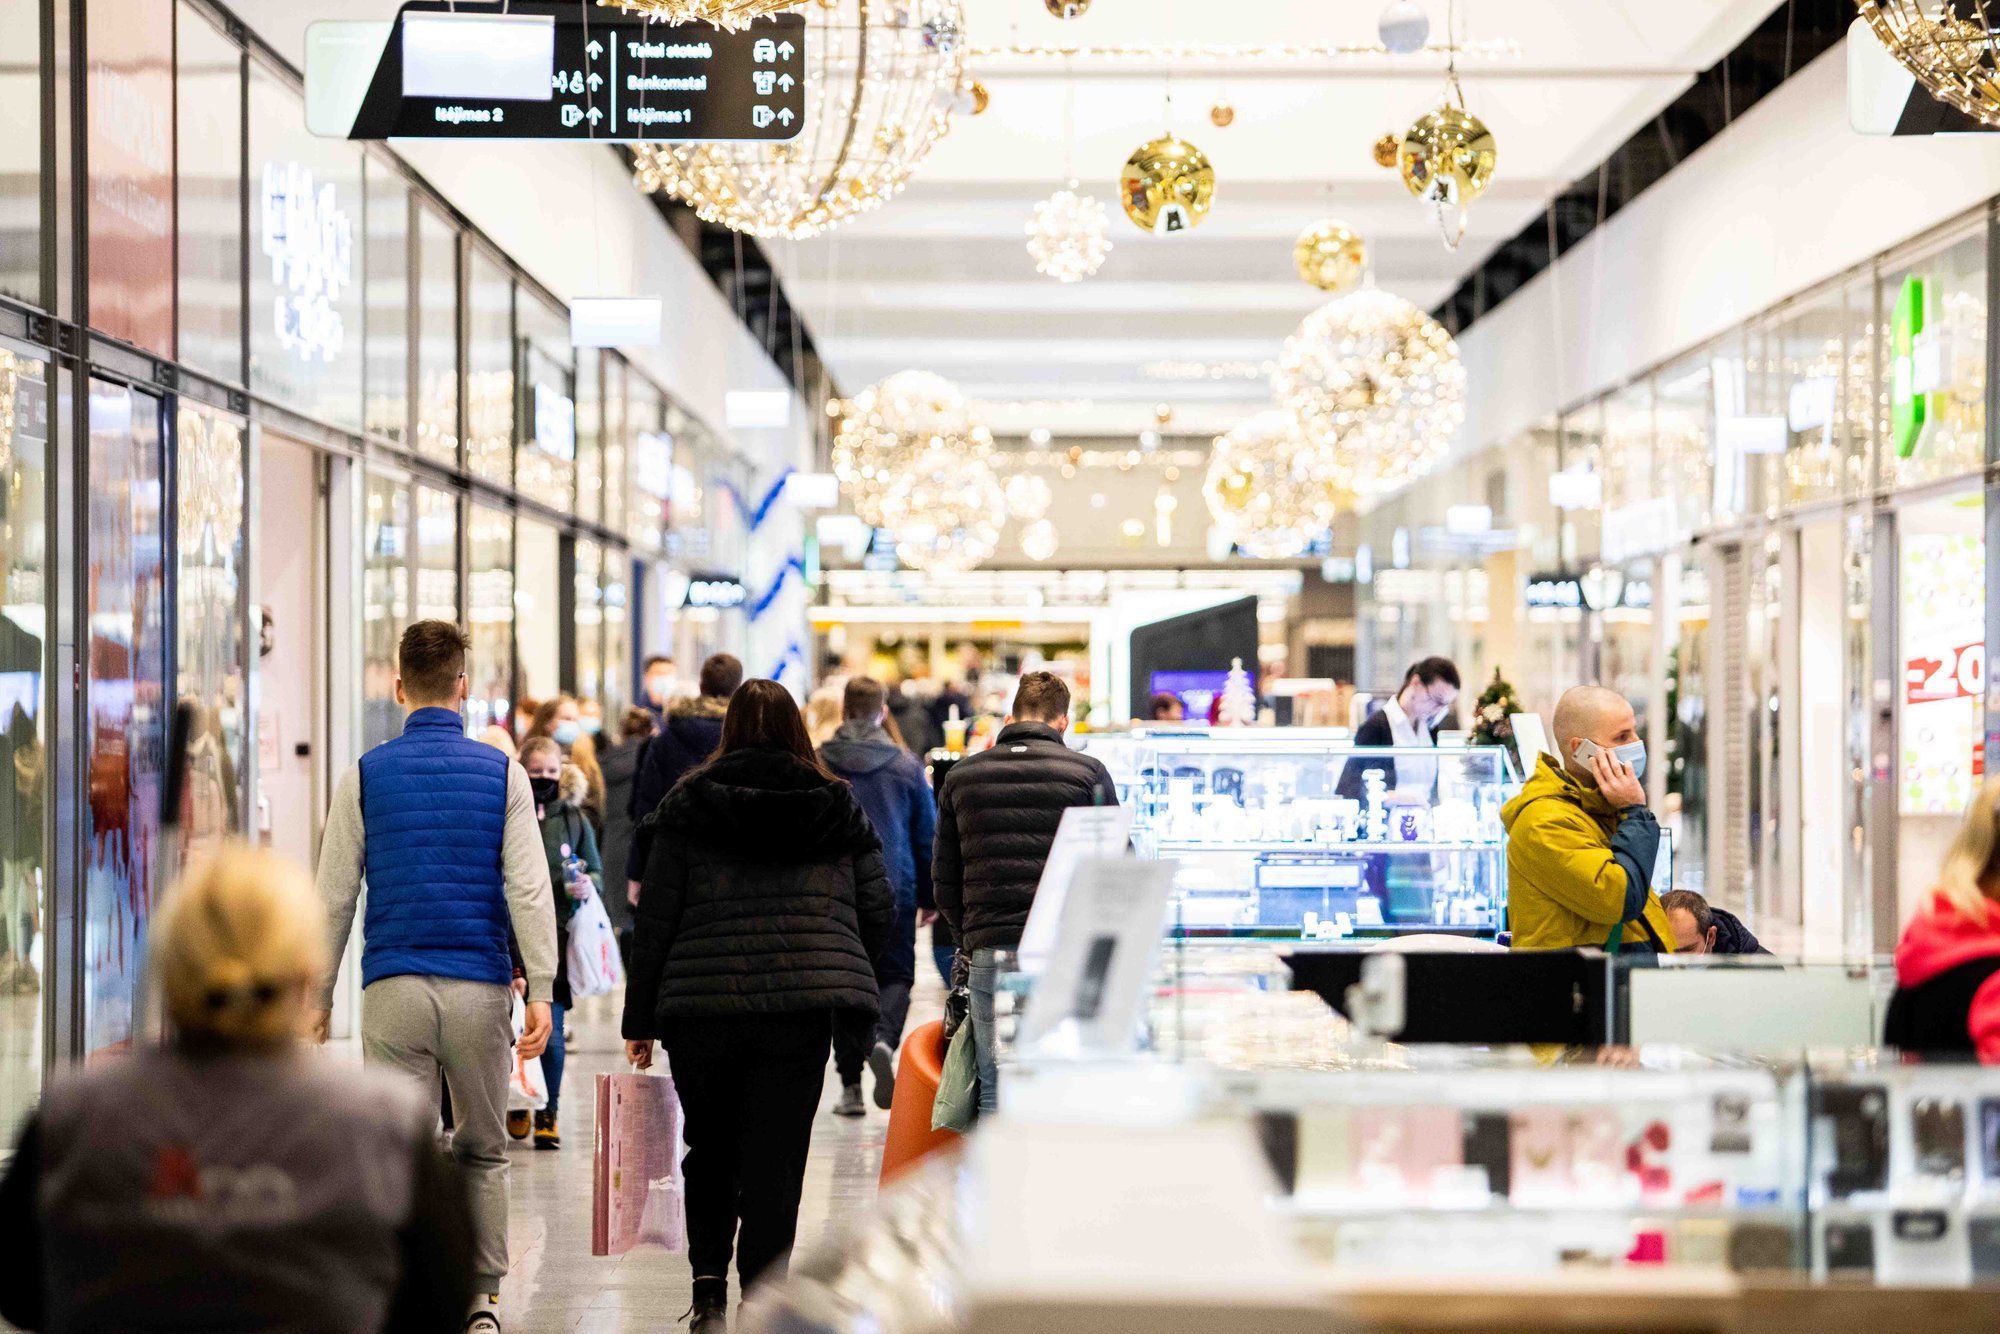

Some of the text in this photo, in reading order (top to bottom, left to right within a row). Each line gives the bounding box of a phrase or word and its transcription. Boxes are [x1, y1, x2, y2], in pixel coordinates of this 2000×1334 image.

[628, 75, 707, 90] Bankomatai
[492, 107, 503, 122] 2
[683, 108, 691, 123] 1
